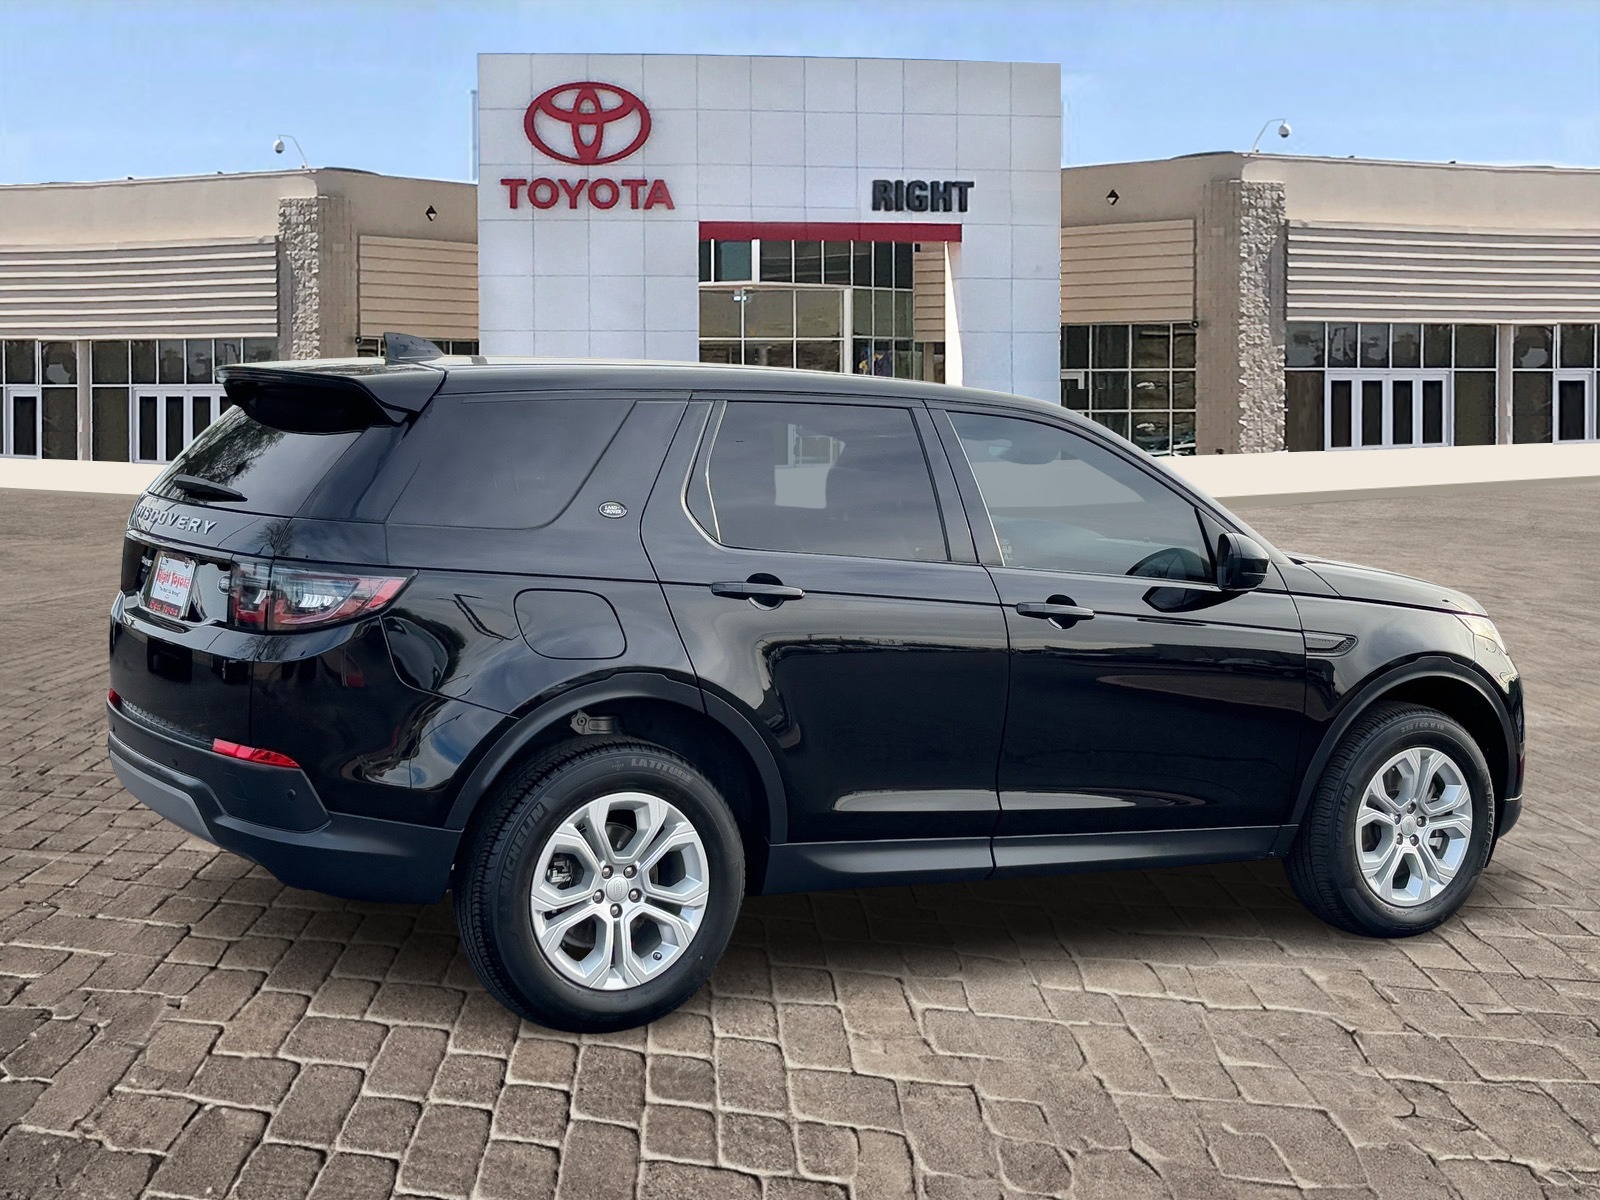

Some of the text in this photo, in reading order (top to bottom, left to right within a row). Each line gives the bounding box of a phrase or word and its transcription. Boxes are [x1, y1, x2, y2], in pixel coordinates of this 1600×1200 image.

[500, 178, 675, 210] TOYOTA
[871, 179, 975, 213] RIGHT
[137, 505, 217, 535] DISCOVERY
[630, 758, 694, 784] LATITUDE
